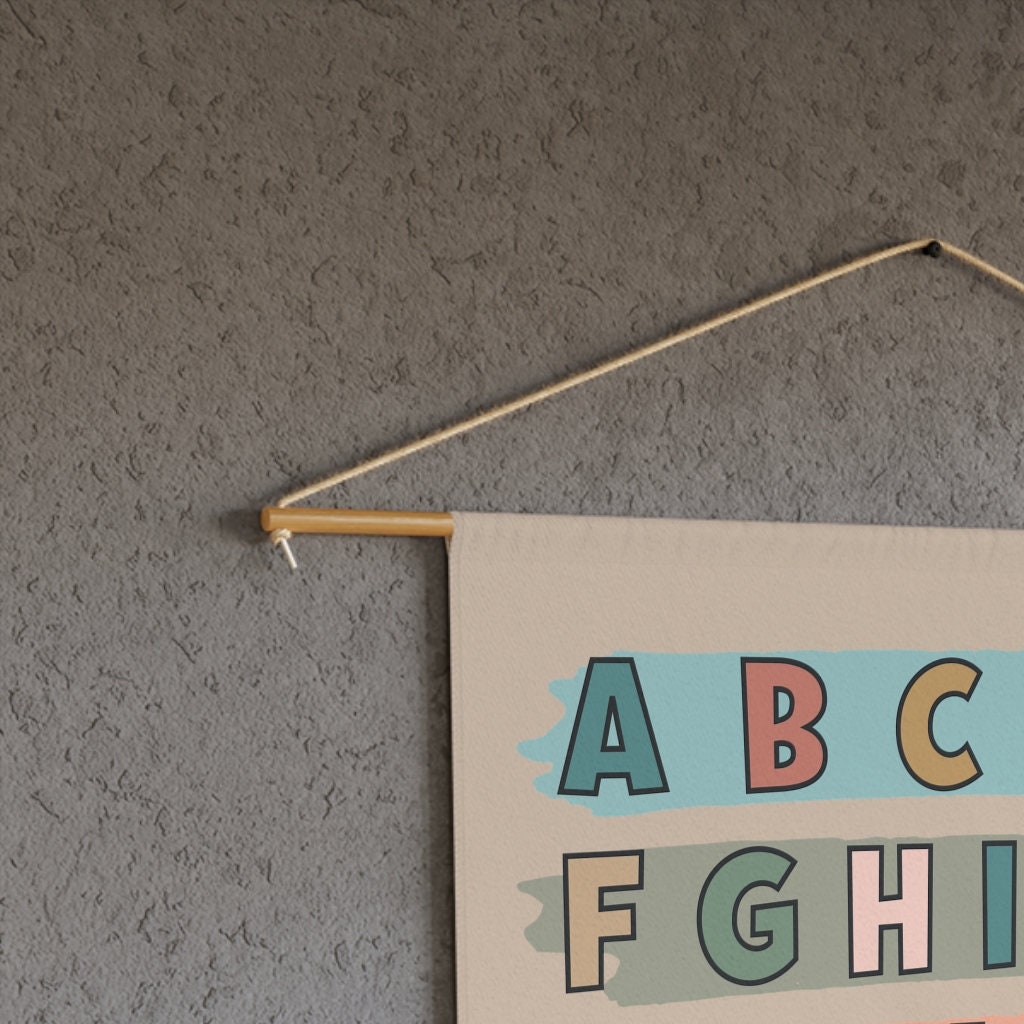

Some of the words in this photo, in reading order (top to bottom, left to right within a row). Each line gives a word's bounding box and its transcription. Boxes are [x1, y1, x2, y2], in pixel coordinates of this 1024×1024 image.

[557, 656, 671, 797] A
[740, 656, 828, 795] B
[895, 657, 984, 792] C
[562, 849, 645, 994] F
[696, 845, 799, 987] G
[846, 843, 934, 979] H
[981, 839, 1018, 971] I
